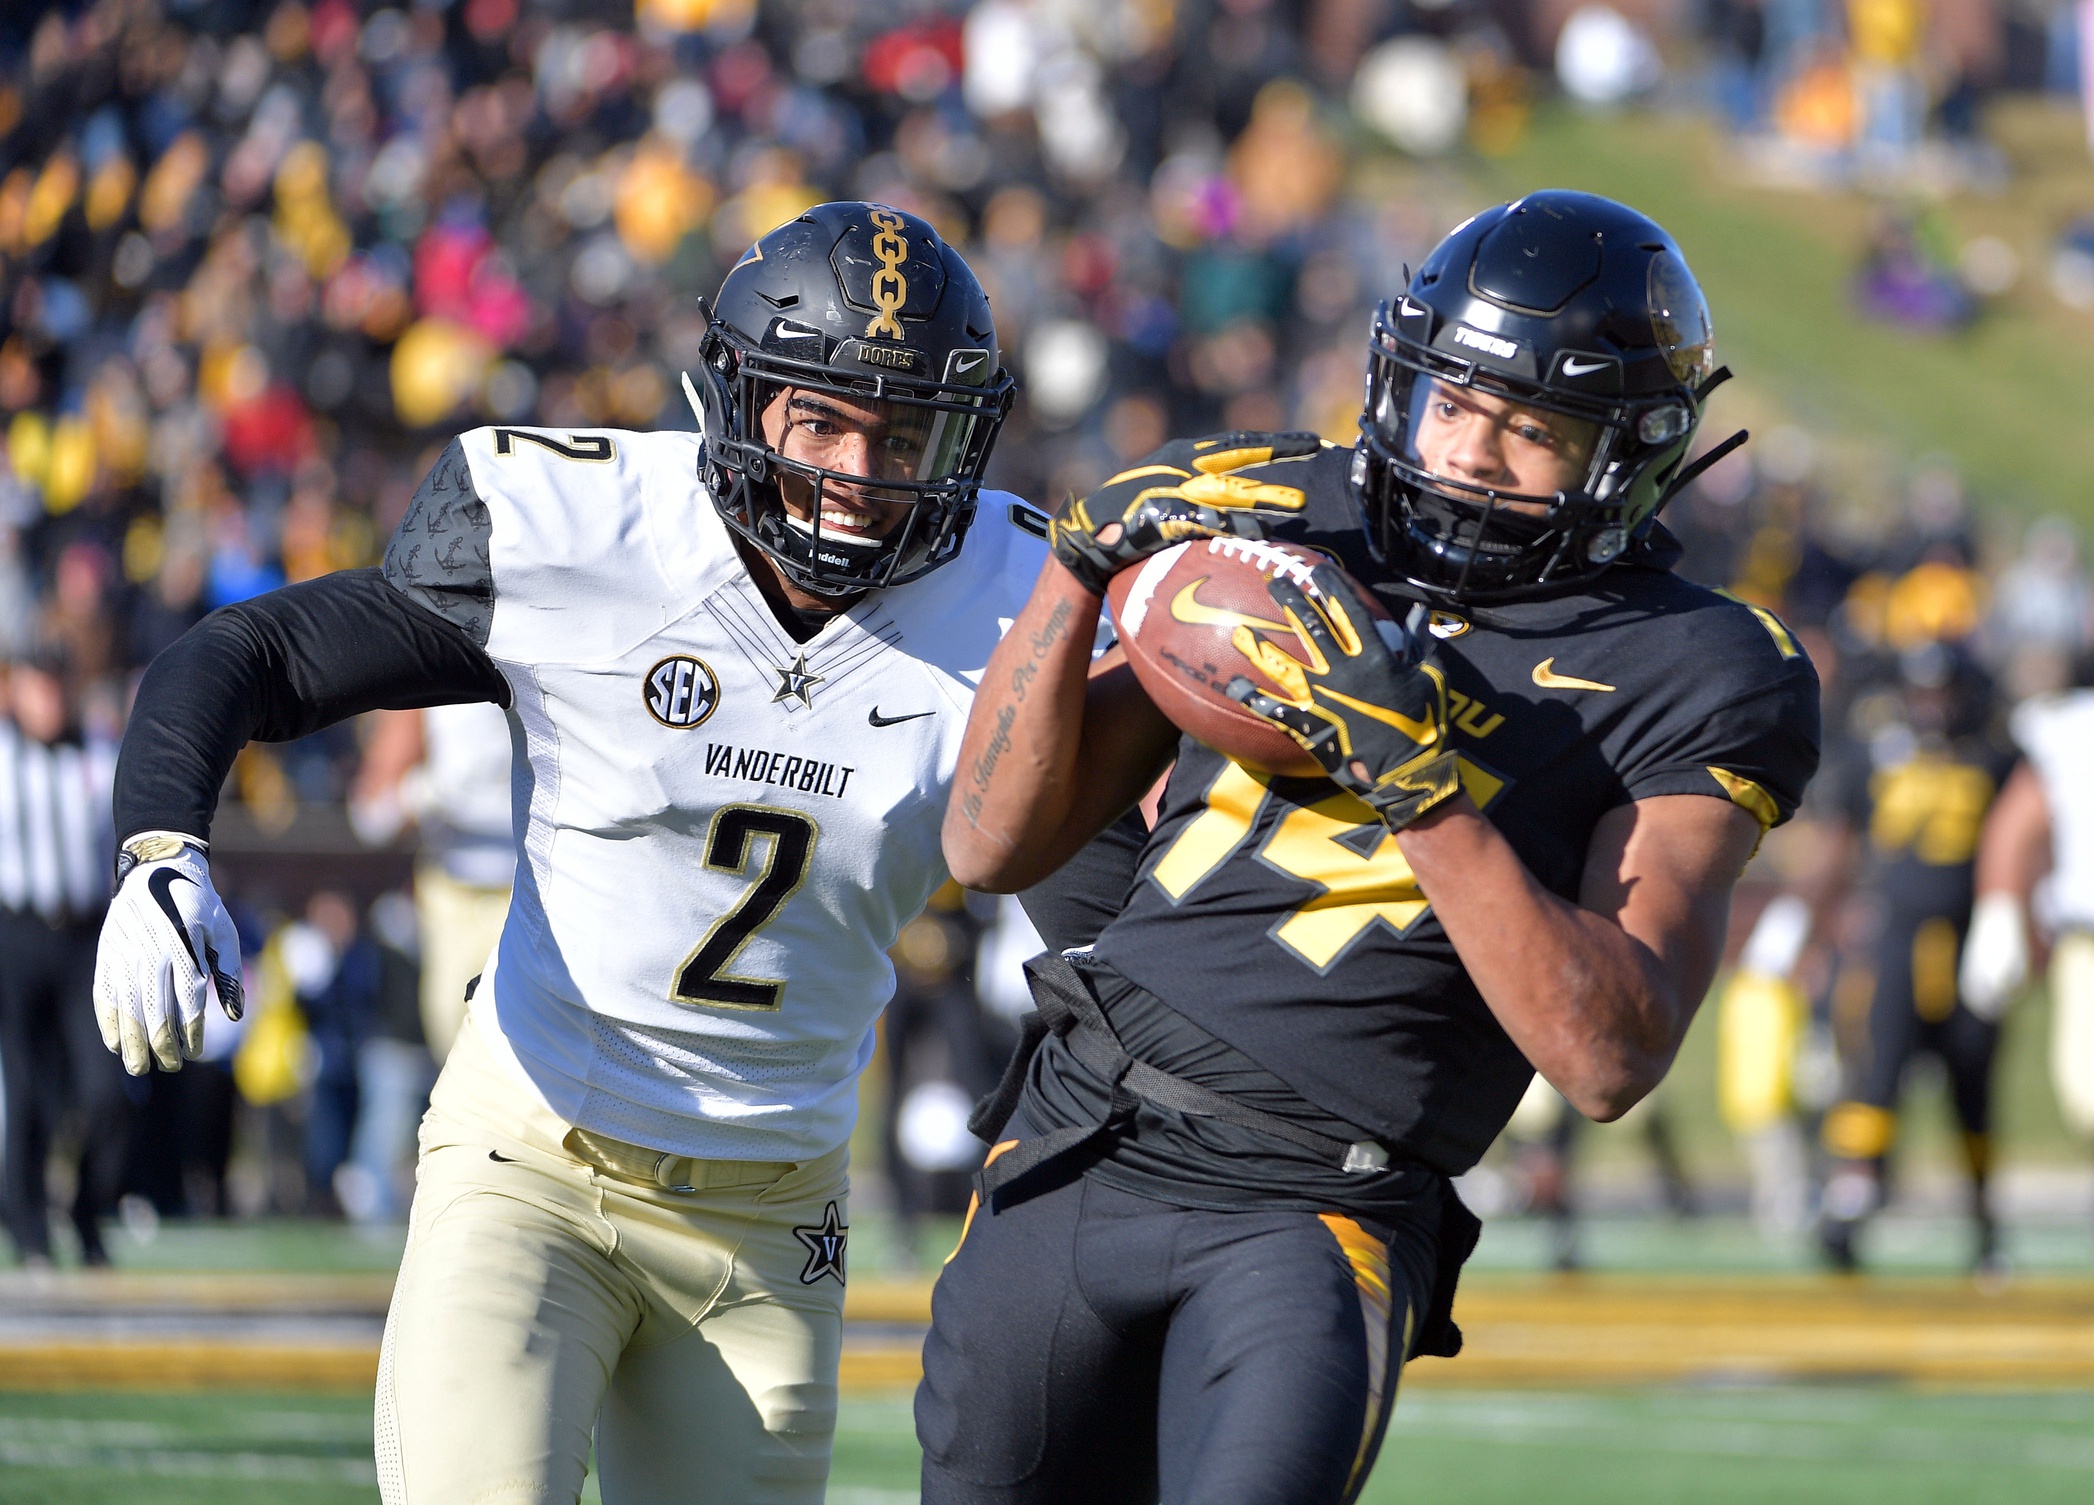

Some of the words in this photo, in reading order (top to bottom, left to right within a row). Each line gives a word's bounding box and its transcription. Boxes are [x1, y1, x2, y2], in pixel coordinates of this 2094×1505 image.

[858, 344, 915, 370] DORES
[491, 428, 618, 465] 2
[649, 658, 712, 724] SEC
[787, 672, 806, 693] V
[704, 742, 855, 799] VANDERBILT
[667, 802, 820, 1013] 2
[822, 1235, 838, 1262] V
